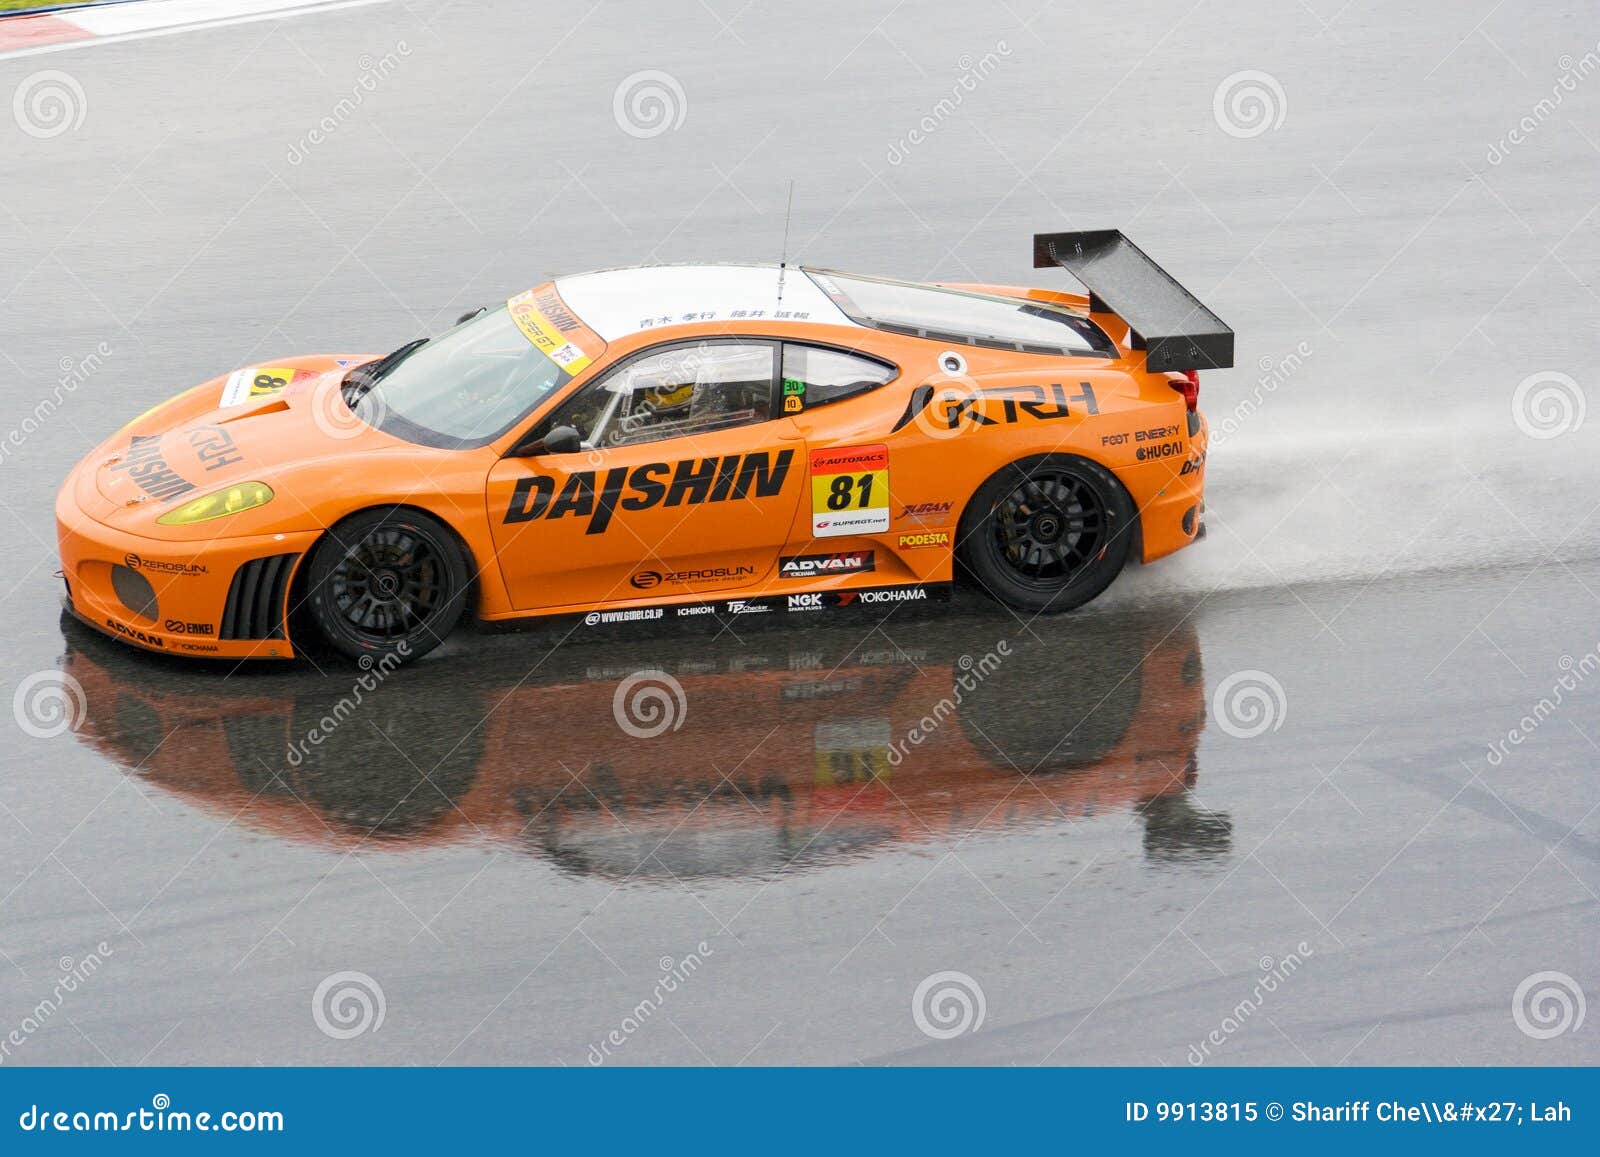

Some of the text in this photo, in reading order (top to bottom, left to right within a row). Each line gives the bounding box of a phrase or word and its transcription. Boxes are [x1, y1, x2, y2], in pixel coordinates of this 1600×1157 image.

[784, 381, 799, 391] 30
[787, 399, 797, 408] 10
[1136, 441, 1183, 461] CHUGAI
[827, 454, 884, 465] AUTOBACS
[827, 473, 873, 511] 81
[899, 533, 949, 546] PODESTA
[142, 559, 206, 573] ZEROSUN
[782, 557, 862, 572] ADVAN
[663, 566, 754, 582] ZEROSUN
[788, 593, 822, 607] NGK
[859, 589, 927, 603] YOKOHAMA
[677, 606, 715, 617] ICHIKOH
[106, 619, 163, 647] ADVAN
[187, 623, 214, 635] ENKEI
